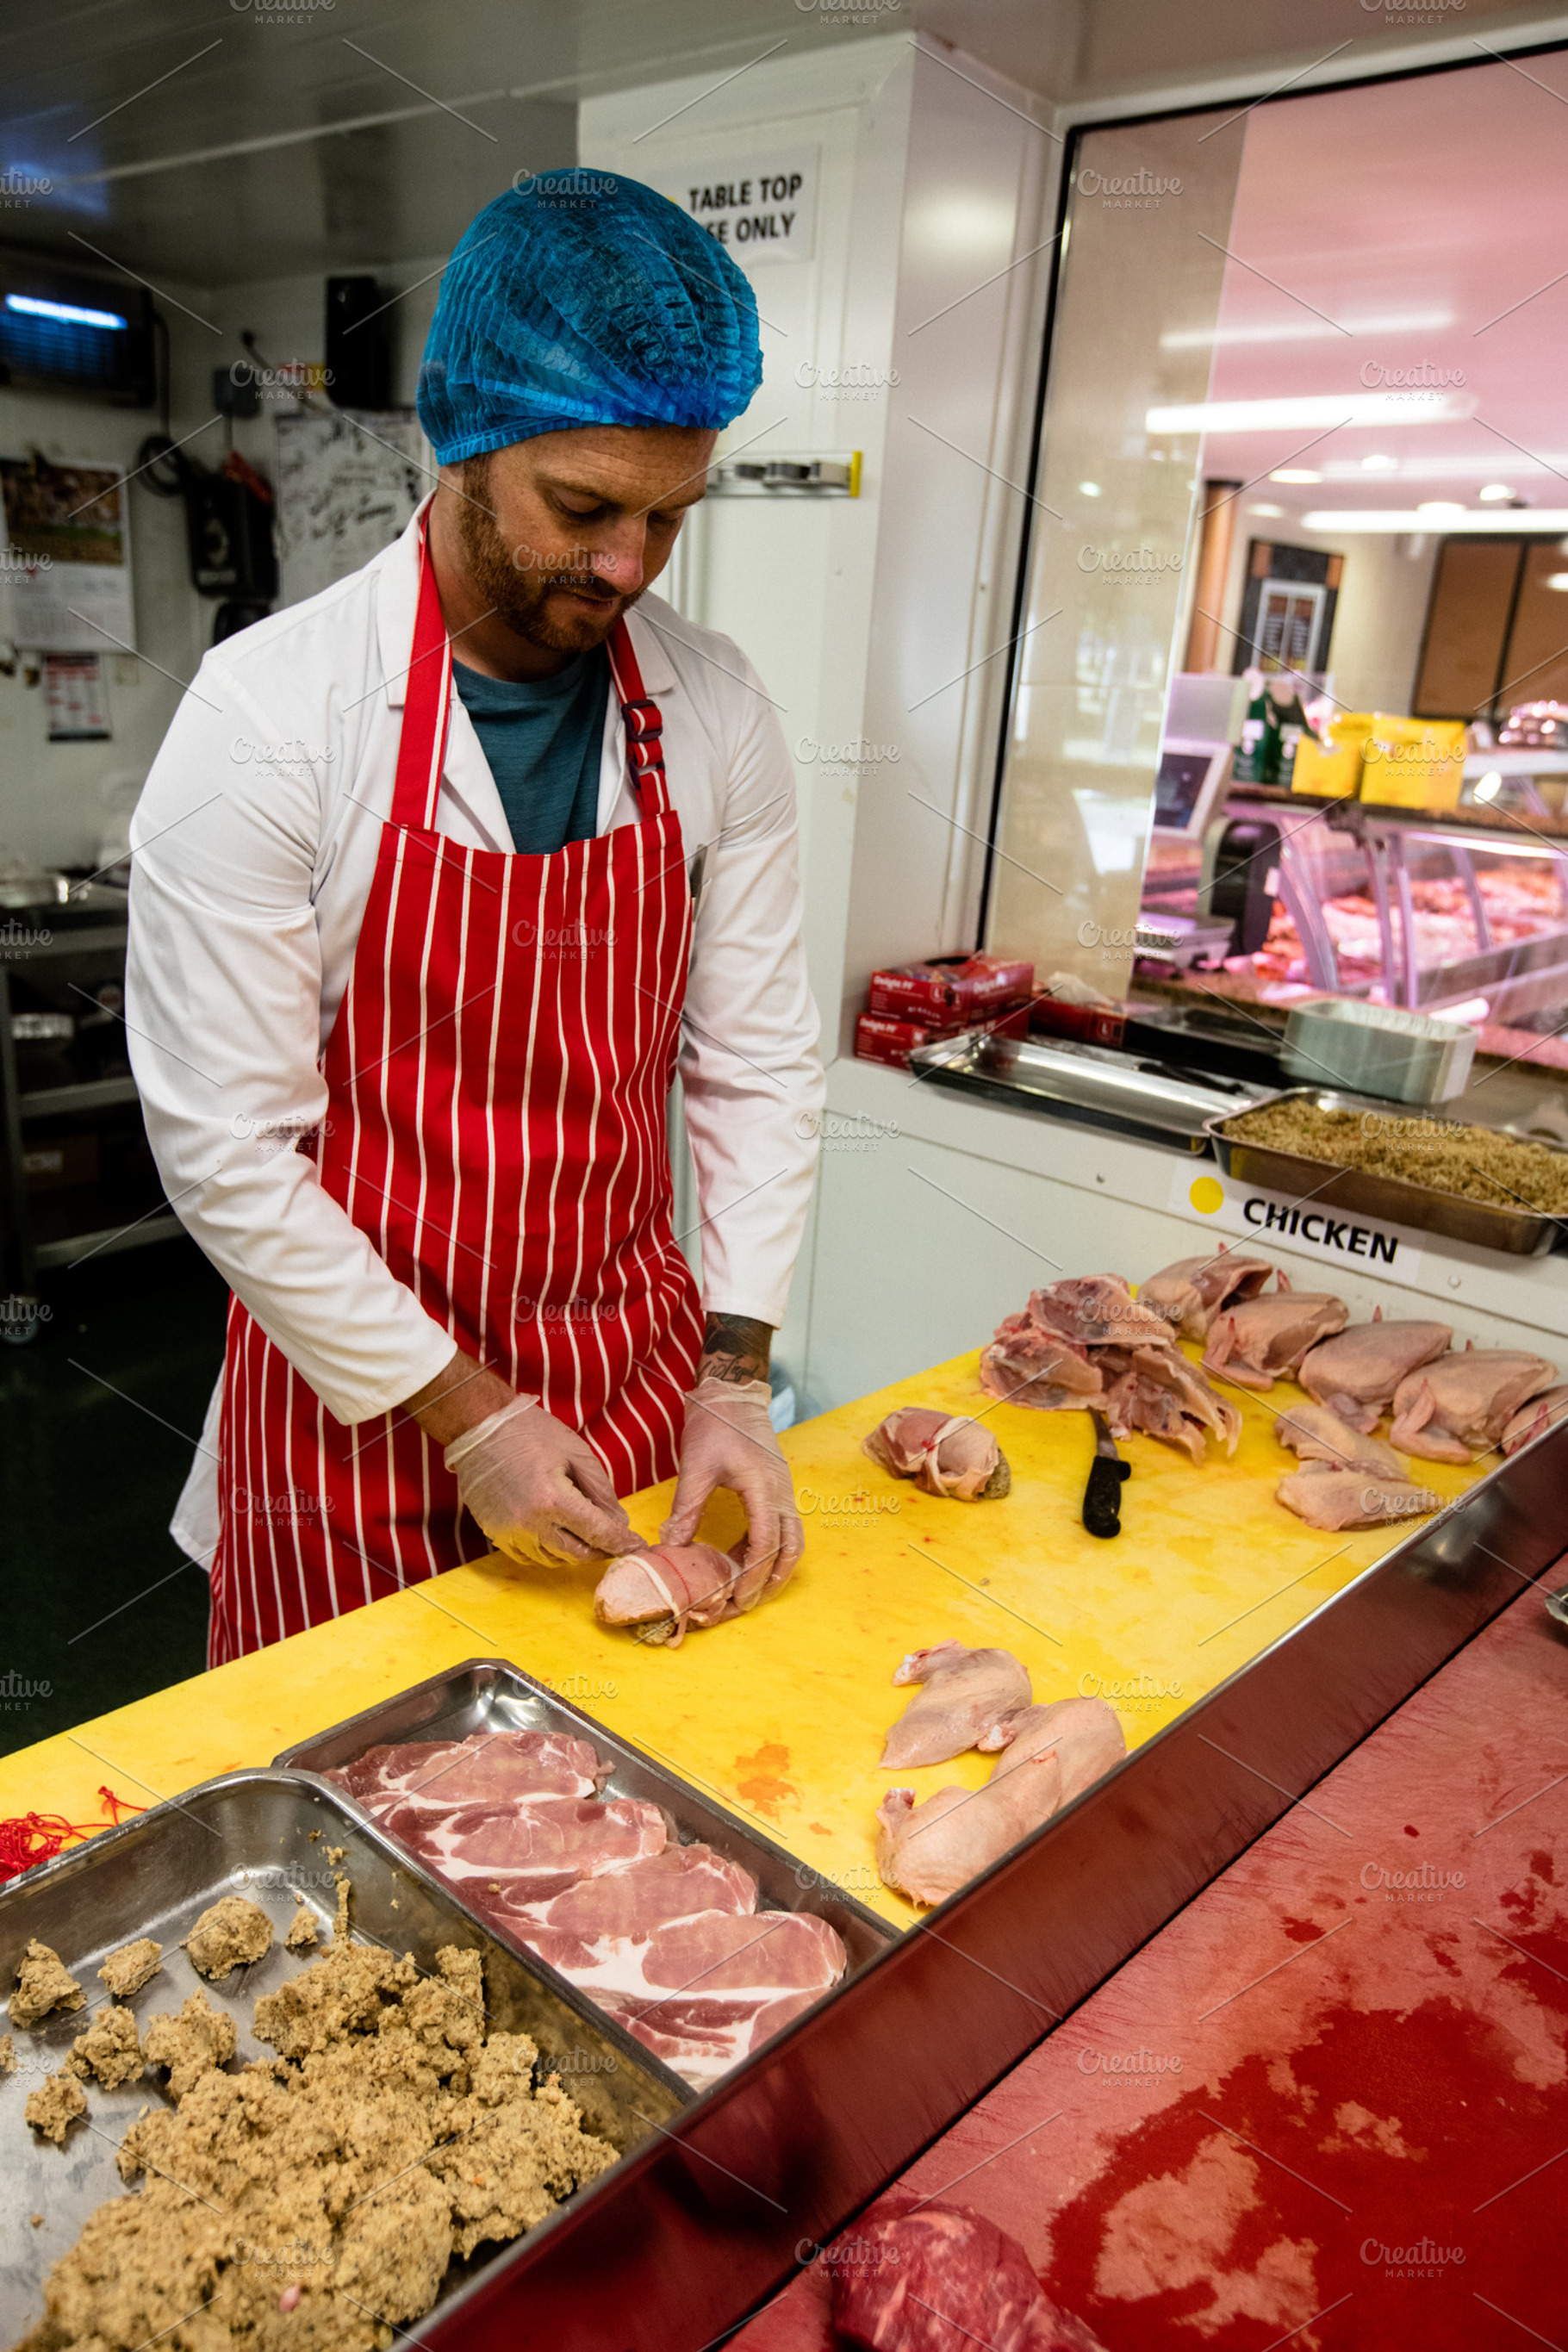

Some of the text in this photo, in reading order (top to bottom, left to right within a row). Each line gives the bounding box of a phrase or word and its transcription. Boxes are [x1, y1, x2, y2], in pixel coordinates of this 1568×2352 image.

[688, 173, 802, 212] TABLE TOP
[704, 212, 795, 244] SE ONLY
[1243, 1198, 1398, 1264] CHICKEN
